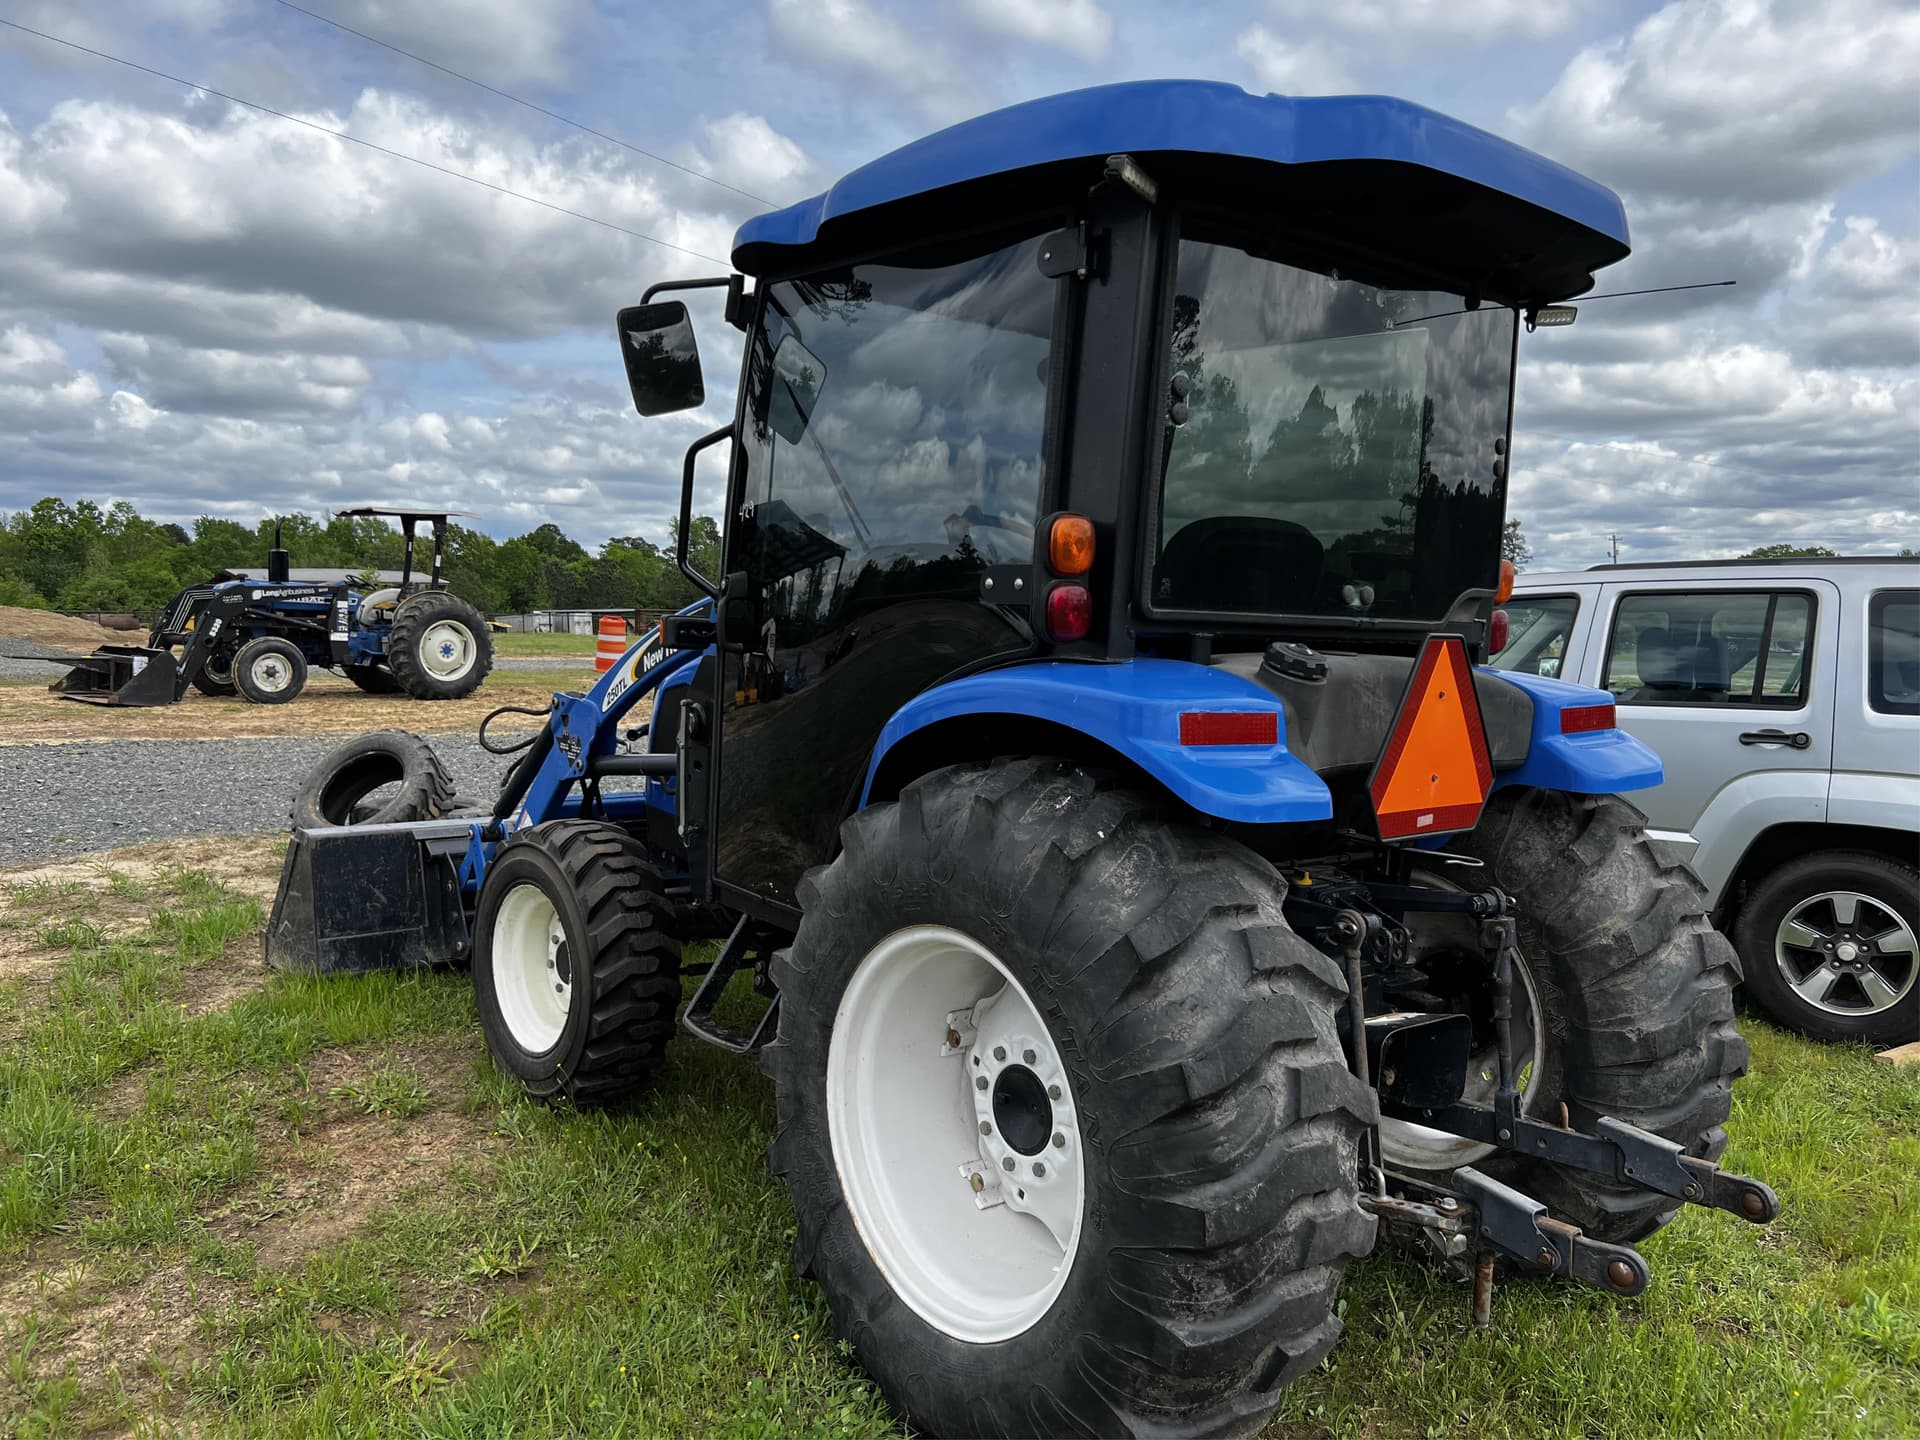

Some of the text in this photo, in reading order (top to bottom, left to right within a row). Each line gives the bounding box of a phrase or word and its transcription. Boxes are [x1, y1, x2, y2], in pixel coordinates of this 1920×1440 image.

[643, 647, 664, 672] New
[606, 677, 627, 706] 250TL
[1031, 962, 1105, 1155] TITAN
